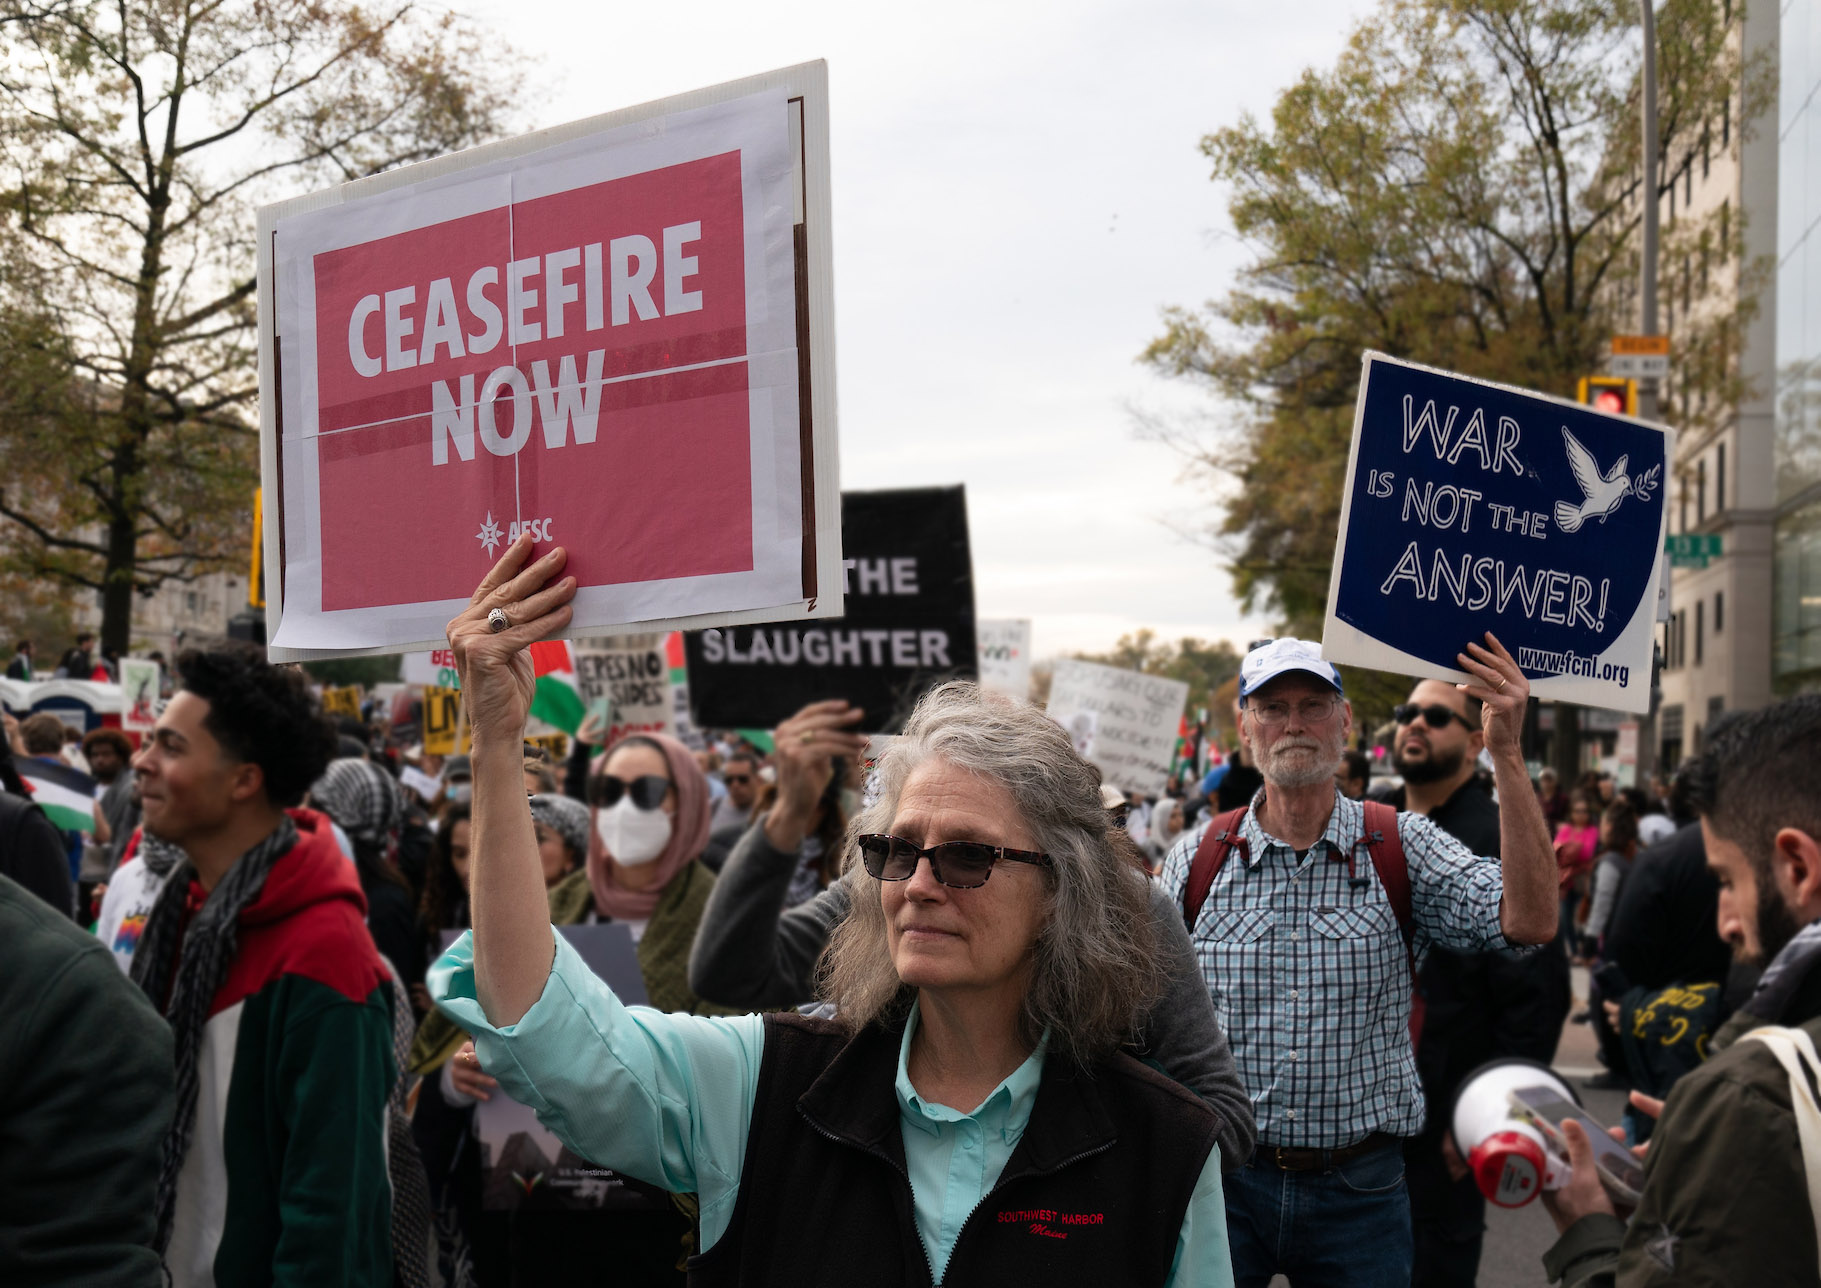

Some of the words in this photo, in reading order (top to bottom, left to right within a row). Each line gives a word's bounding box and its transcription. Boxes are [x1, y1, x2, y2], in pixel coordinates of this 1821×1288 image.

[348, 220, 703, 377] CEASEFIRE
[431, 349, 605, 466] NOW
[1402, 394, 1524, 476] WAR
[1367, 469, 1394, 498] IS
[1402, 477, 1482, 533] NOT
[1488, 503, 1550, 539] THE
[1380, 541, 1610, 633] ANSWER!
[702, 628, 950, 666] SLAUGHTER
[1518, 647, 1629, 688] www.fcnl.org
[997, 1209, 1058, 1223] SOUTHWEST
[1061, 1212, 1104, 1225] HARBOR
[1028, 1223, 1068, 1239] Maine
